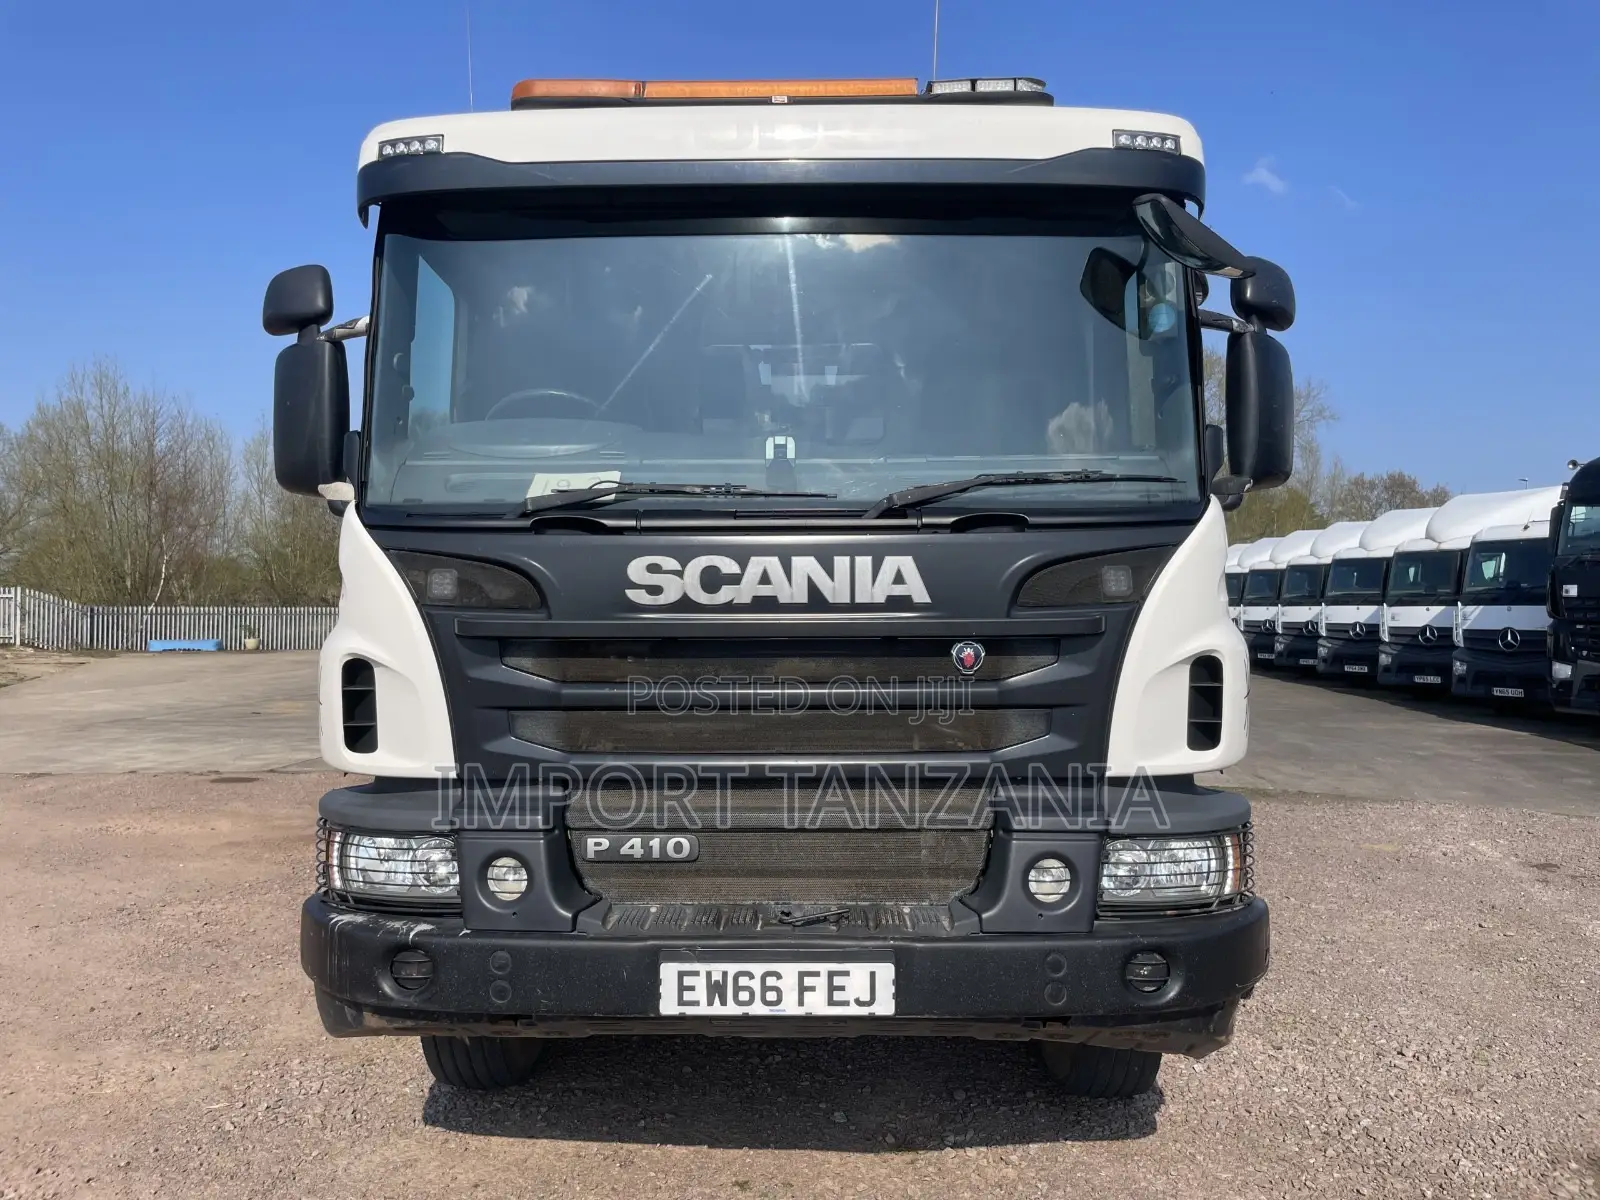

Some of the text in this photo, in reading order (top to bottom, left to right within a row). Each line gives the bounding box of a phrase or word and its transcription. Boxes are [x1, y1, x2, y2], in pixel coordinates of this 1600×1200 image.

[625, 555, 932, 605] SCANIA
[586, 838, 691, 859] P 410
[677, 970, 876, 1007] EW66 FEJ
